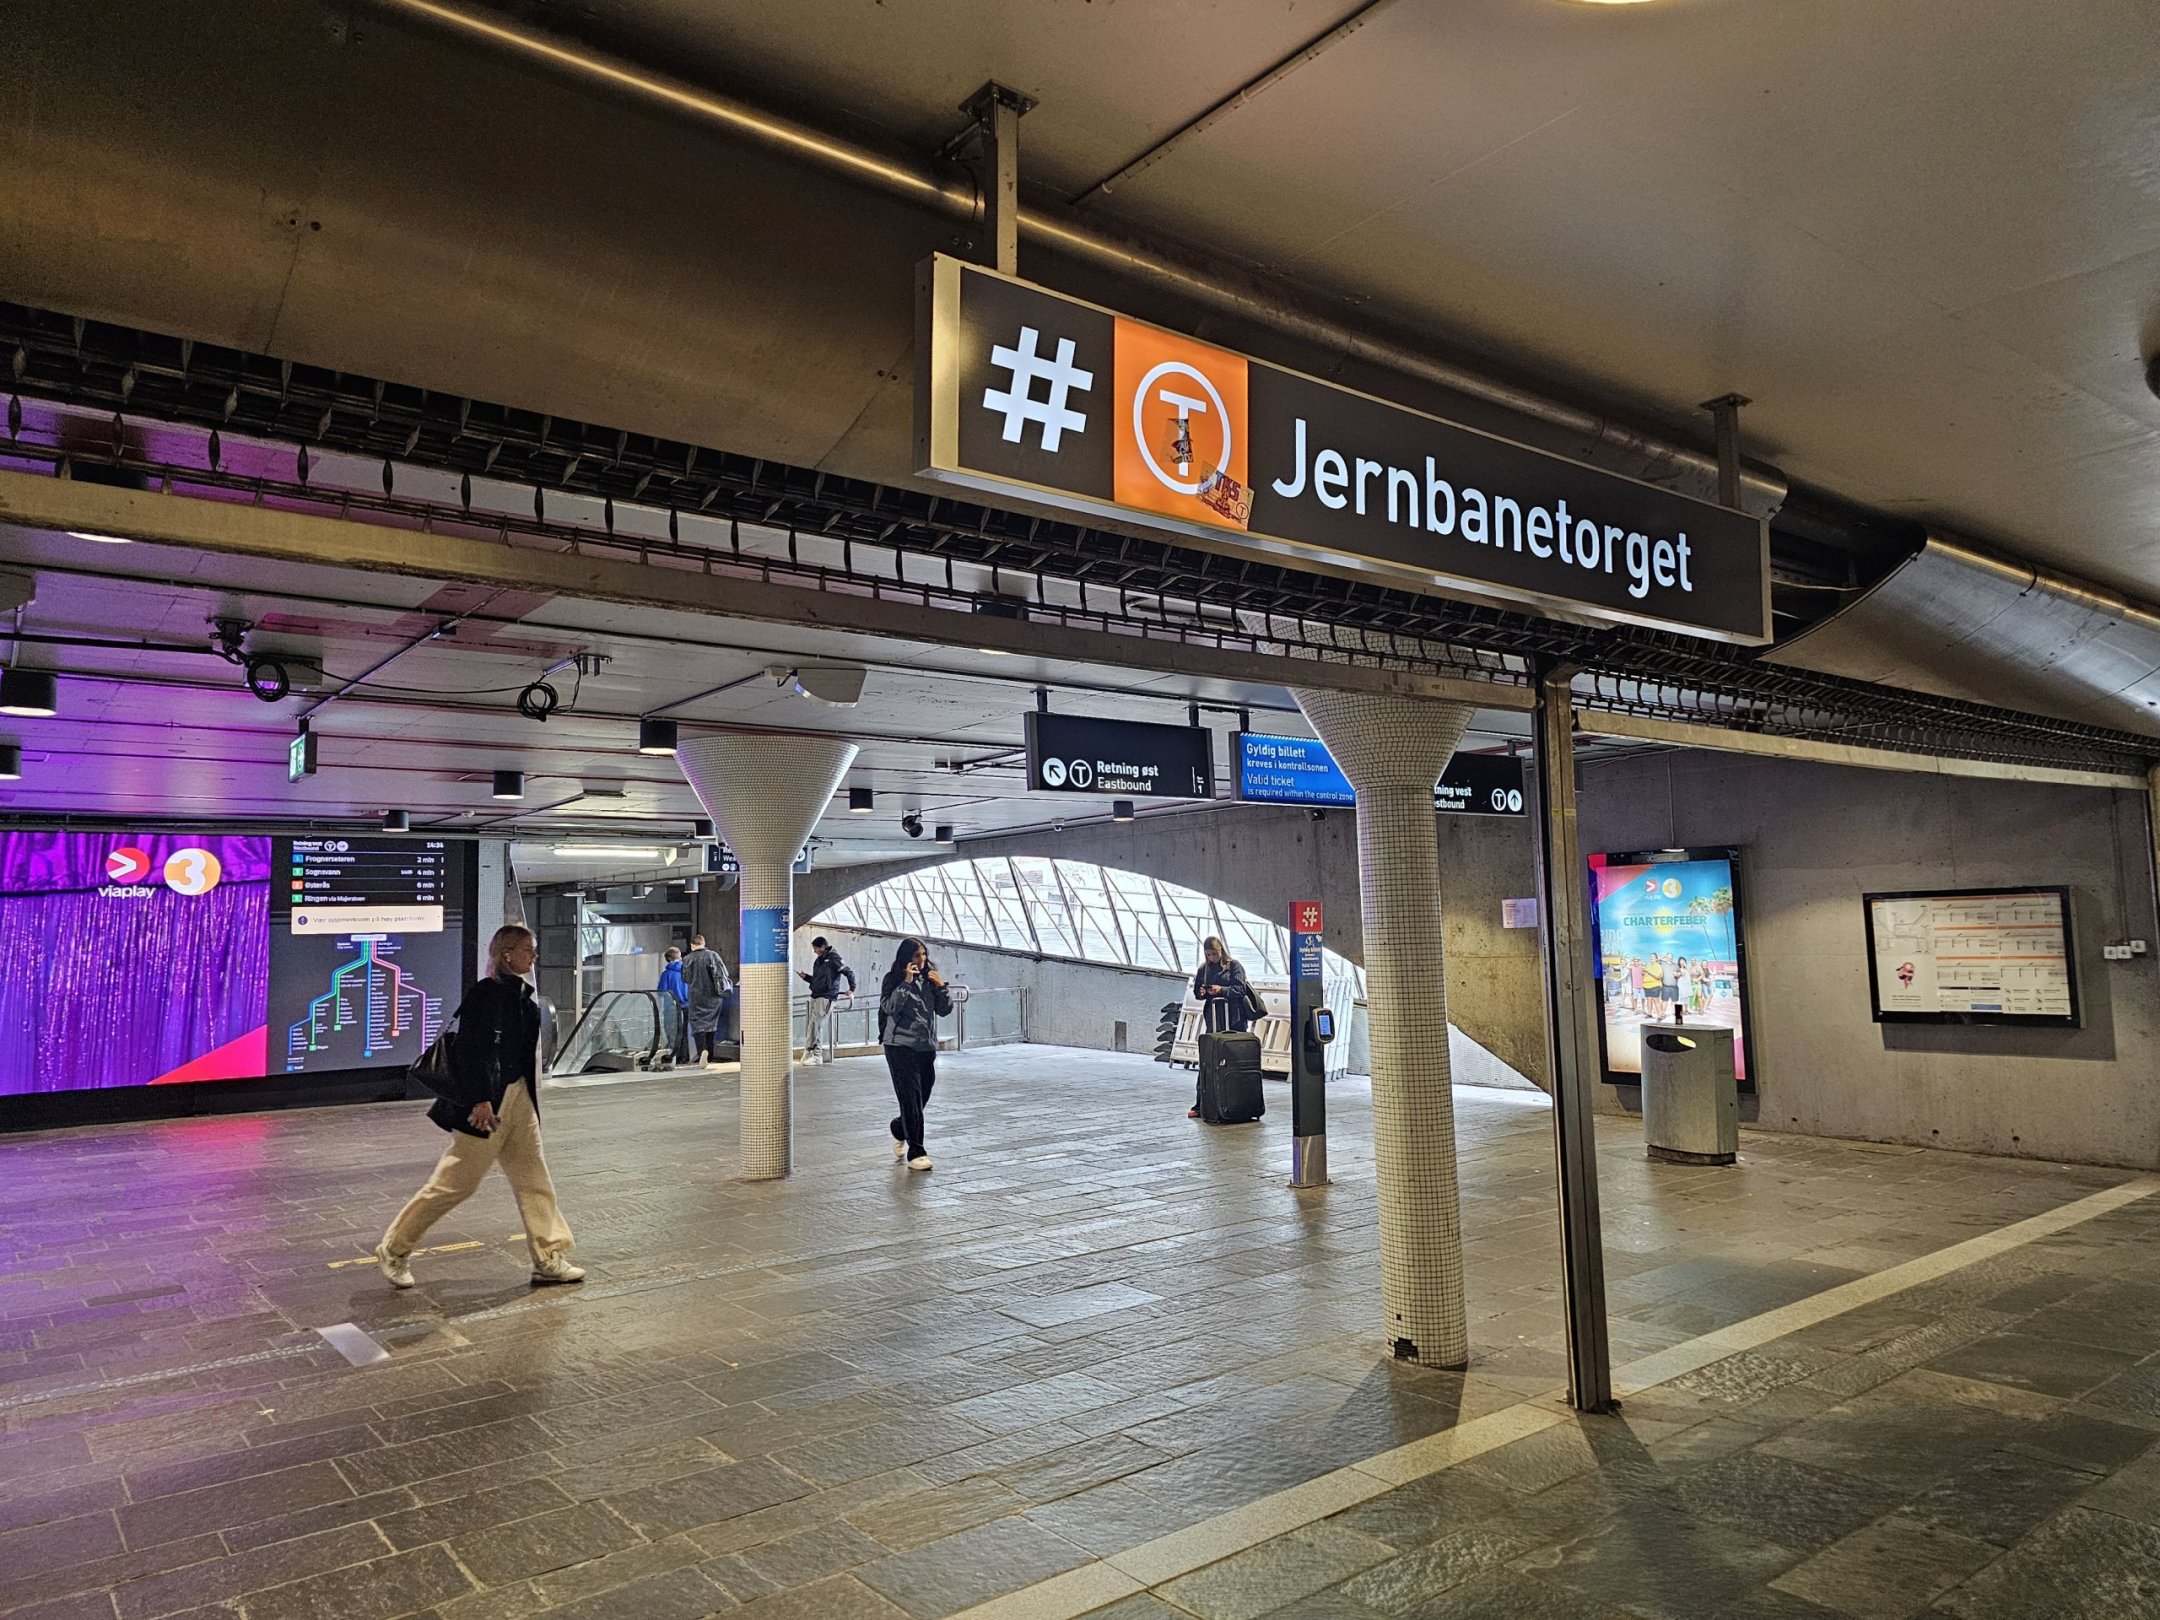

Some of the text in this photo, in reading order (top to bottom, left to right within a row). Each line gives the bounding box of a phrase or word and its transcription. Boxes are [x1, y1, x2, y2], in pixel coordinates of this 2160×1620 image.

[1272, 418, 1693, 599] Jernbanetorget
[1246, 743, 1306, 758] Gyldig billett
[1097, 760, 1159, 778] Retning øst
[1247, 758, 1328, 773] kreves i kontrollsonen
[1097, 777, 1152, 791] Eastbound
[1247, 773, 1295, 787] Valid ticket
[1255, 788, 1283, 797] required
[1284, 790, 1304, 798] within
[1305, 790, 1315, 798] the
[1316, 791, 1338, 800] control
[1338, 793, 1353, 801] zone
[1434, 785, 1472, 797] tning vest
[305, 855, 355, 863] Frognerseteren
[98, 885, 156, 899] viaplay
[305, 881, 330, 889] Østerås
[304, 895, 328, 903] Ringen
[1623, 915, 1708, 926] CHARTERFEBER
